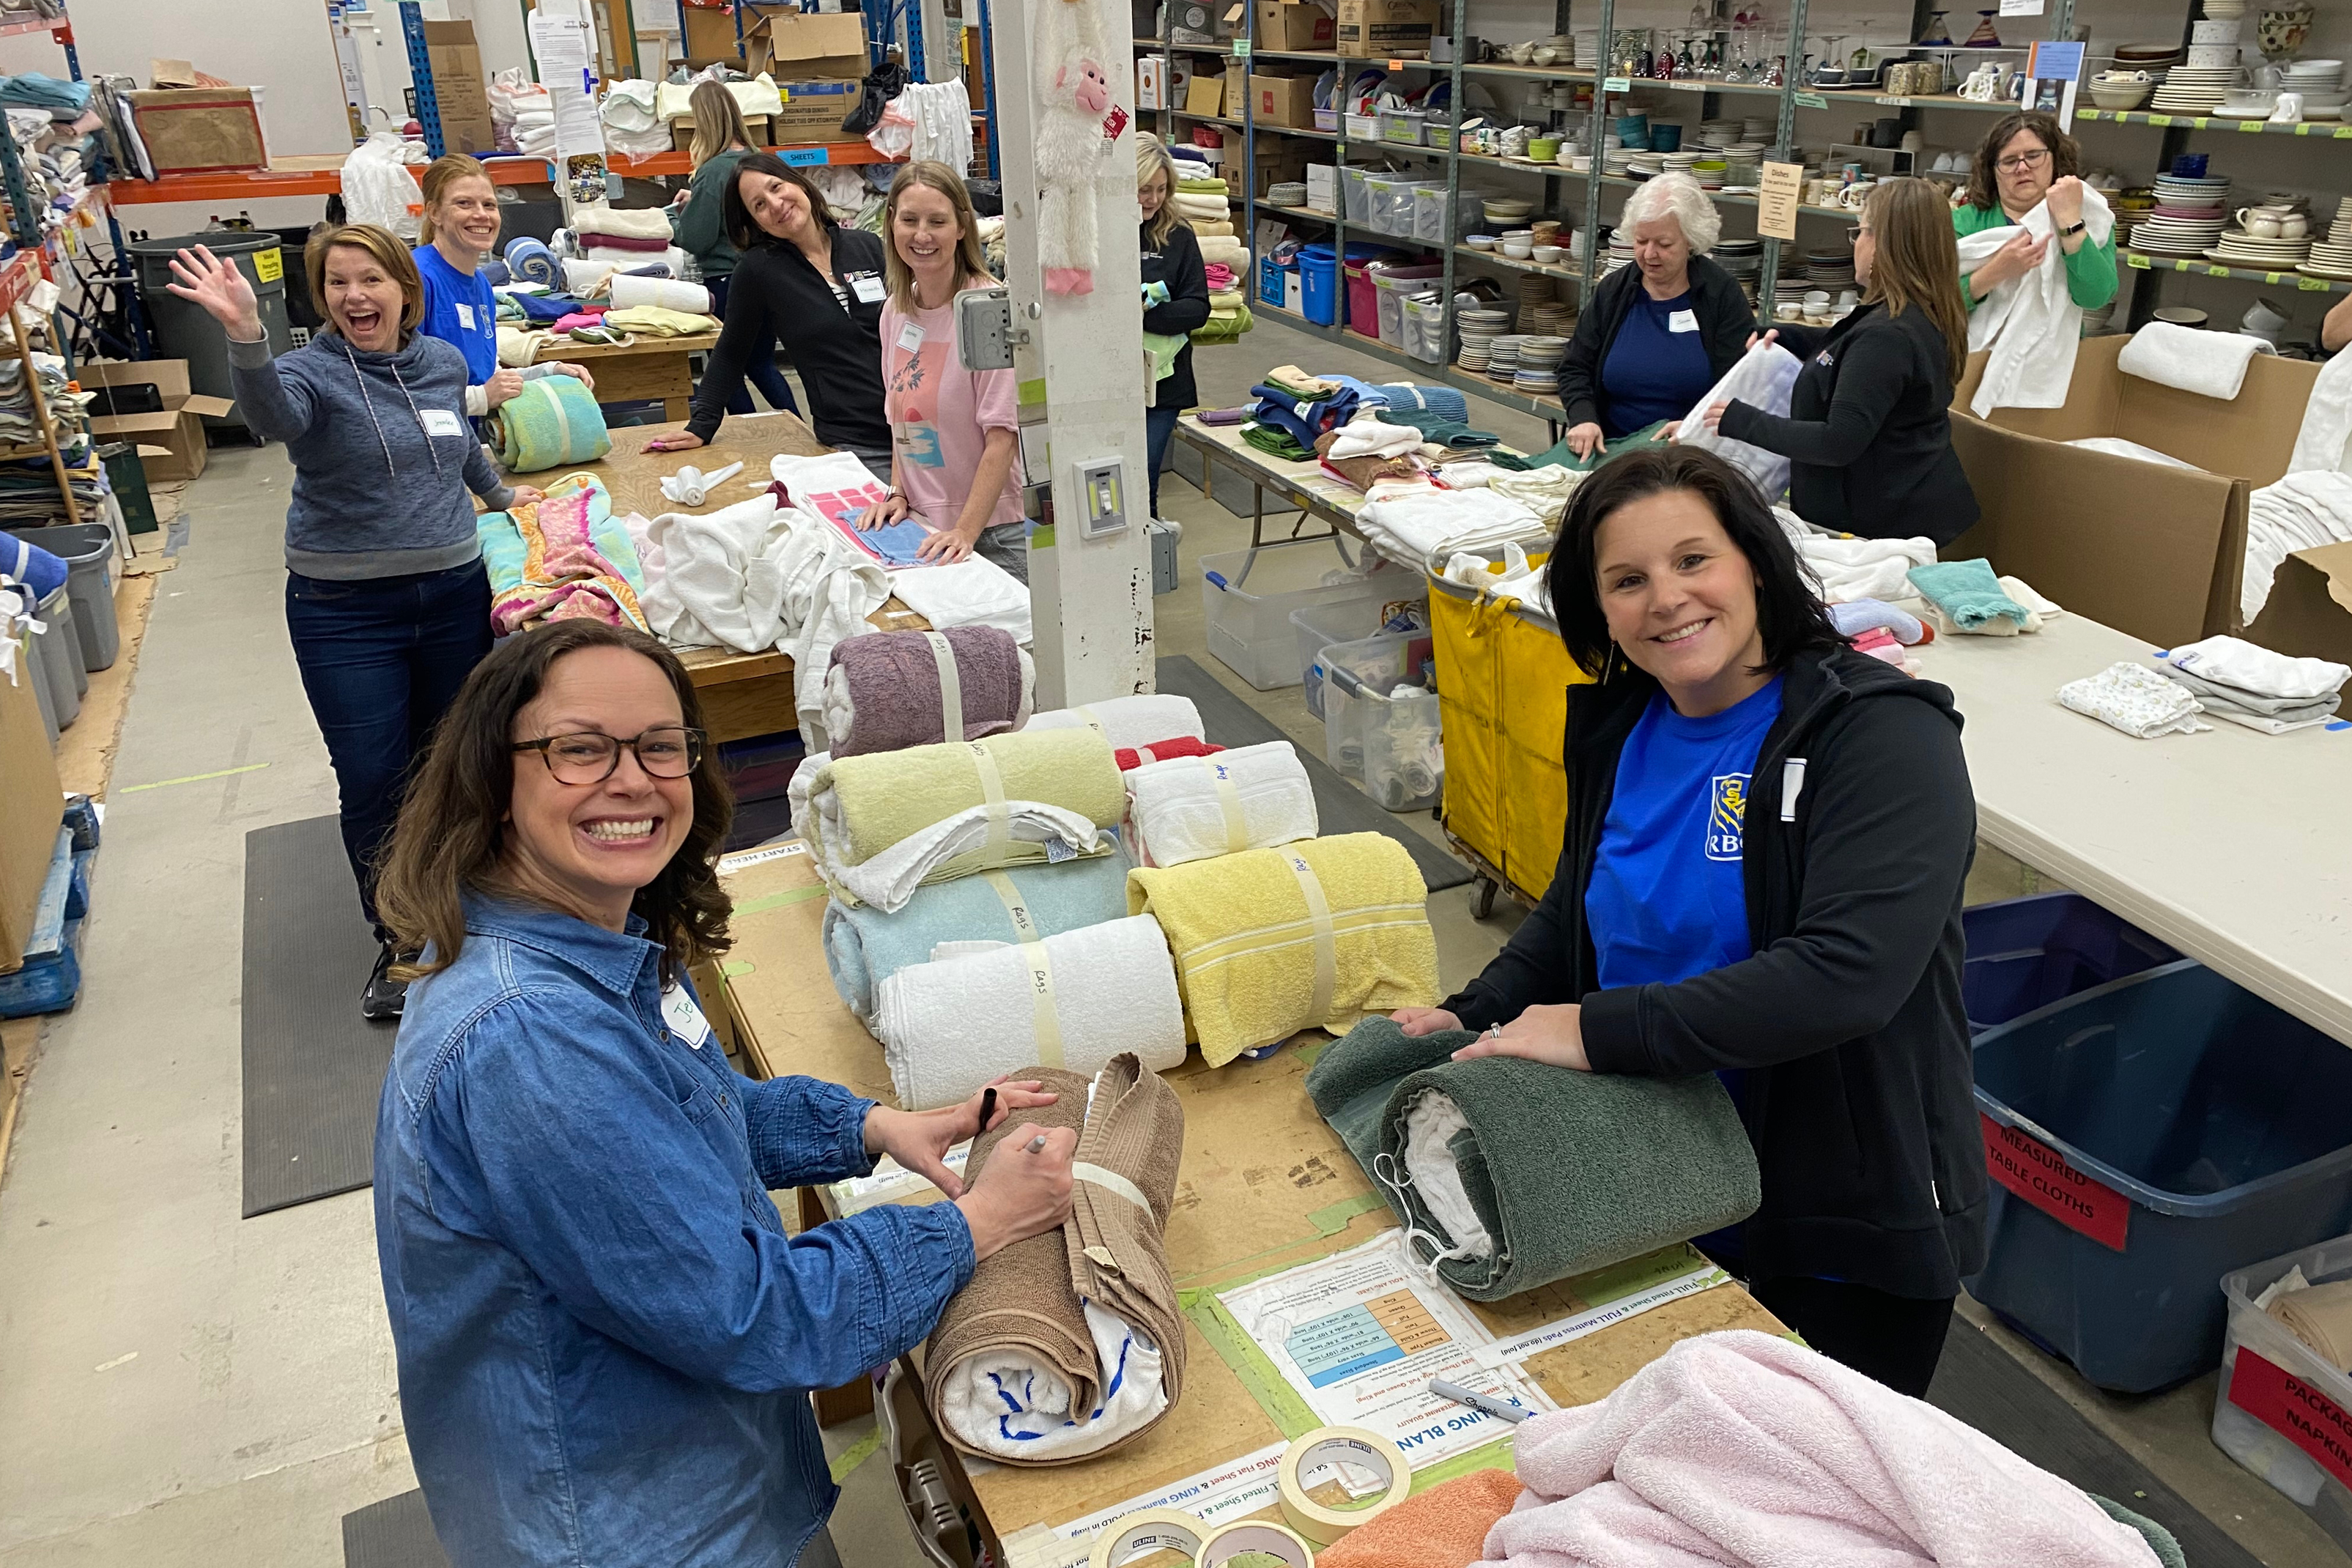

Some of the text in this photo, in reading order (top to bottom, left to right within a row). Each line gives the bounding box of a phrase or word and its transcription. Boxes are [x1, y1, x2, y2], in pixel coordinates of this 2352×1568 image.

[790, 152, 815, 161] SHEETS
[1771, 169, 1789, 178] Dishes
[1709, 835, 1743, 854] RB
[725, 845, 801, 865] START HERE
[1012, 907, 1029, 929] Rags
[1034, 970, 1048, 994] Rags
[2000, 1125, 2087, 1186] MEASURED
[1989, 1145, 2096, 1220] TABLE CLOTHS
[1387, 1274, 1404, 1285] ROLL
[1355, 1285, 1374, 1297] LABEL
[1382, 1295, 1397, 1306] King
[1387, 1303, 1406, 1314] Queen
[1325, 1315, 1339, 1325] wide
[1398, 1313, 1410, 1322] Full
[1501, 1281, 1697, 1356] FULL Fitted Sheet & FULL Mattress Pads (do not fold)
[1293, 1326, 1306, 1336] long
[1333, 1323, 1348, 1333] wide
[1403, 1321, 1418, 1331] Twin
[1419, 1325, 1437, 1336] Throw
[1301, 1334, 1315, 1345] long
[1353, 1337, 1369, 1347] wide
[1399, 1333, 1414, 1343] Child
[1408, 1335, 1443, 1352] Blanket Type
[1309, 1342, 1323, 1352] long
[1306, 1354, 1321, 1364] long
[1336, 1350, 1364, 1364] Sizes vary
[1460, 1356, 1475, 1366] SIZE
[1338, 1358, 1378, 1377] Standard Sizes
[1436, 1361, 1461, 1375] (Throw,
[1405, 1375, 1421, 1386] Full,
[1385, 1380, 1407, 1394] Queen
[1355, 1392, 1374, 1405] King)
[1372, 1388, 1386, 1398] and
[1395, 1384, 1500, 1429] INSPE DETERMINE QUALITY
[1465, 1397, 1499, 1416] Sharpie
[1391, 1394, 1523, 1454] RLING BLAN
[1350, 1441, 1372, 1454] ULINE
[1236, 1464, 1254, 1475] Flat
[1209, 1471, 1236, 1485] Sheet
[1199, 1480, 1210, 1491] &
[1168, 1486, 1200, 1502] KING
[1240, 1485, 1269, 1501] Fitted
[1213, 1495, 1241, 1511] Sheet
[1203, 1506, 1214, 1516] &
[1090, 1522, 1101, 1532] in
[1133, 1536, 1156, 1548] ULINE
